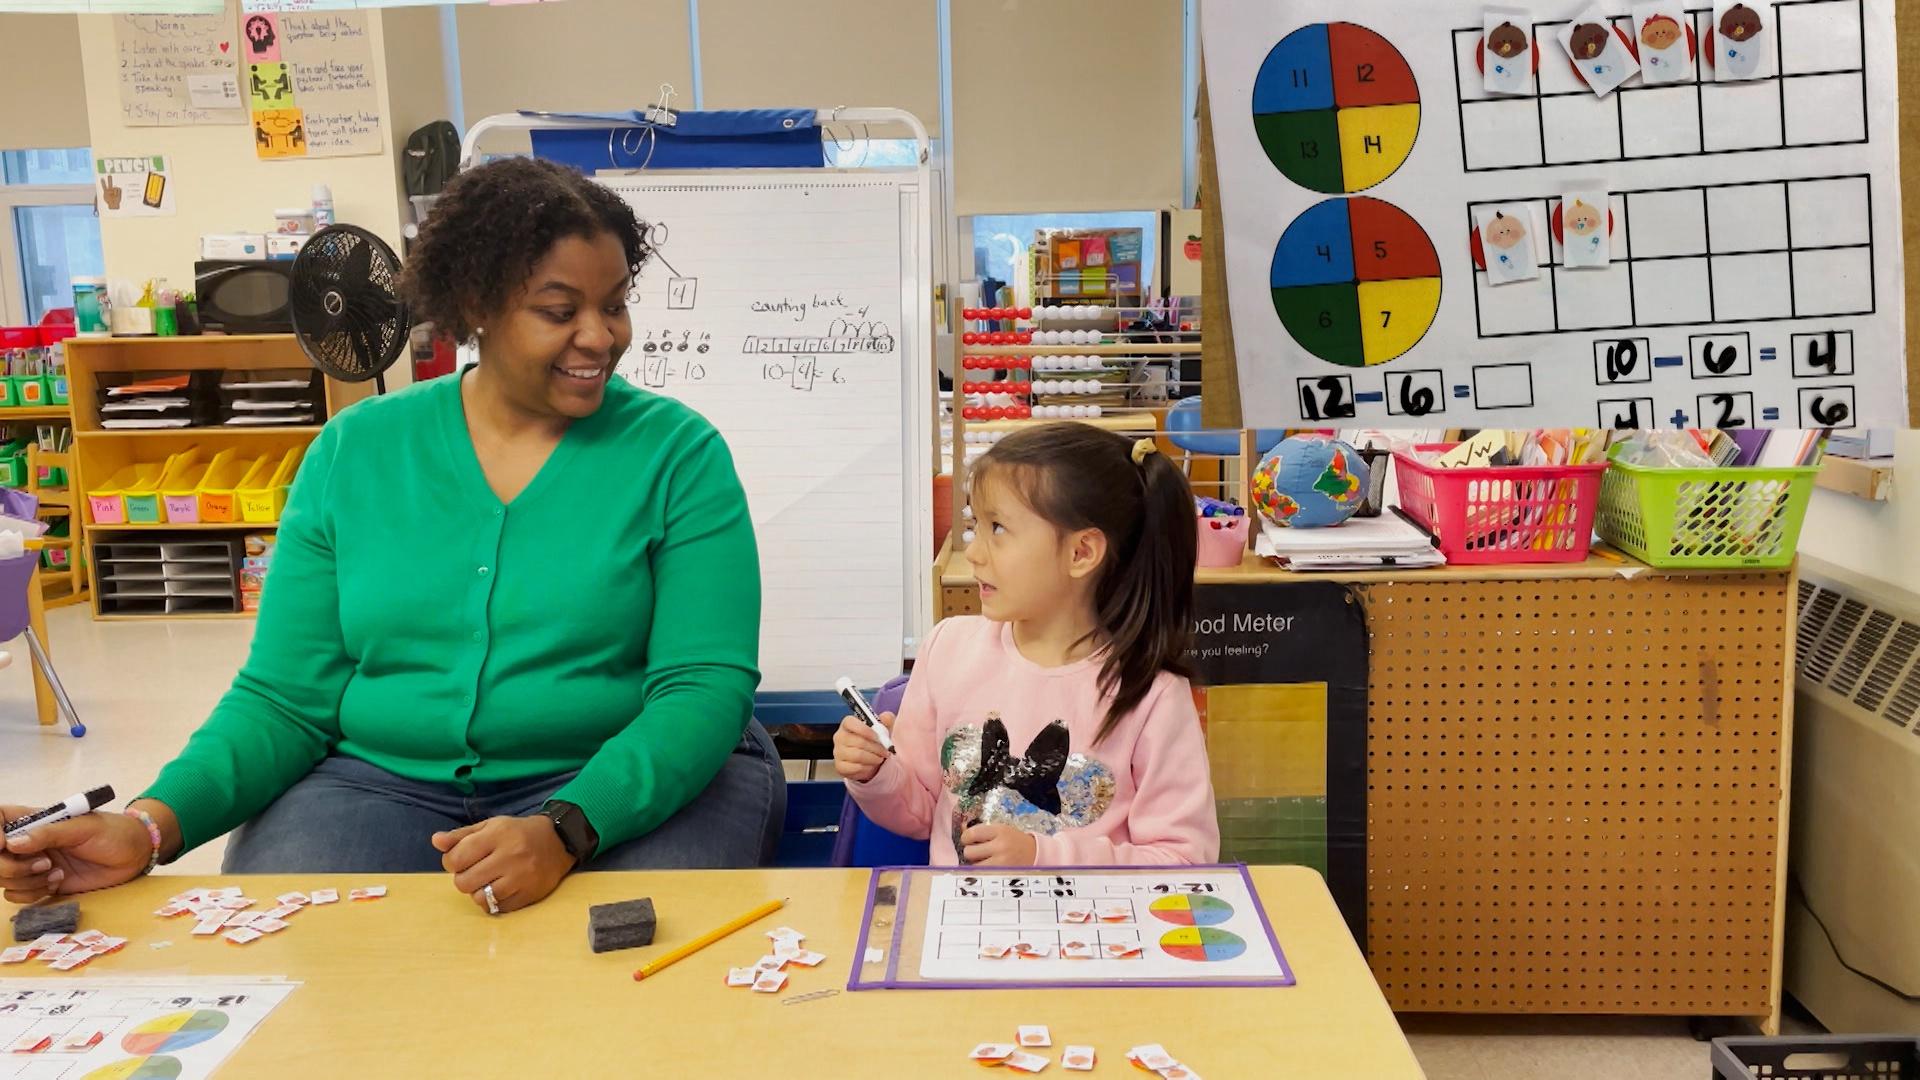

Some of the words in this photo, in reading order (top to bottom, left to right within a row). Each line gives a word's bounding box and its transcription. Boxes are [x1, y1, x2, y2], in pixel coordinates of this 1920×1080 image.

[162, 42, 179, 53] with
[1292, 68, 1309, 89] 11
[1357, 63, 1375, 83] 12
[137, 103, 160, 124] Stay
[167, 110, 179, 119] on
[1301, 140, 1319, 160] 13
[1363, 135, 1382, 154] 14
[104, 158, 157, 174] PENCIL
[1316, 244, 1332, 263] 4
[1374, 241, 1387, 259] 5
[673, 283, 687, 304] 4
[812, 294, 848, 308] back
[1318, 311, 1333, 329] 6
[1380, 310, 1392, 328] 7
[1606, 338, 1638, 381] 10
[1703, 340, 1737, 374] 6
[1808, 330, 1837, 374] 4
[685, 361, 706, 381] 10
[1302, 376, 1355, 421] 12
[1400, 374, 1435, 416] 6
[1712, 394, 1746, 429] 2
[1810, 396, 1849, 426] 6
[96, 502, 116, 513] Pink
[247, 502, 272, 513] Yellow
[1233, 613, 1295, 632] Meter
[1201, 648, 1221, 660] you
[1224, 643, 1270, 658] feeling?
